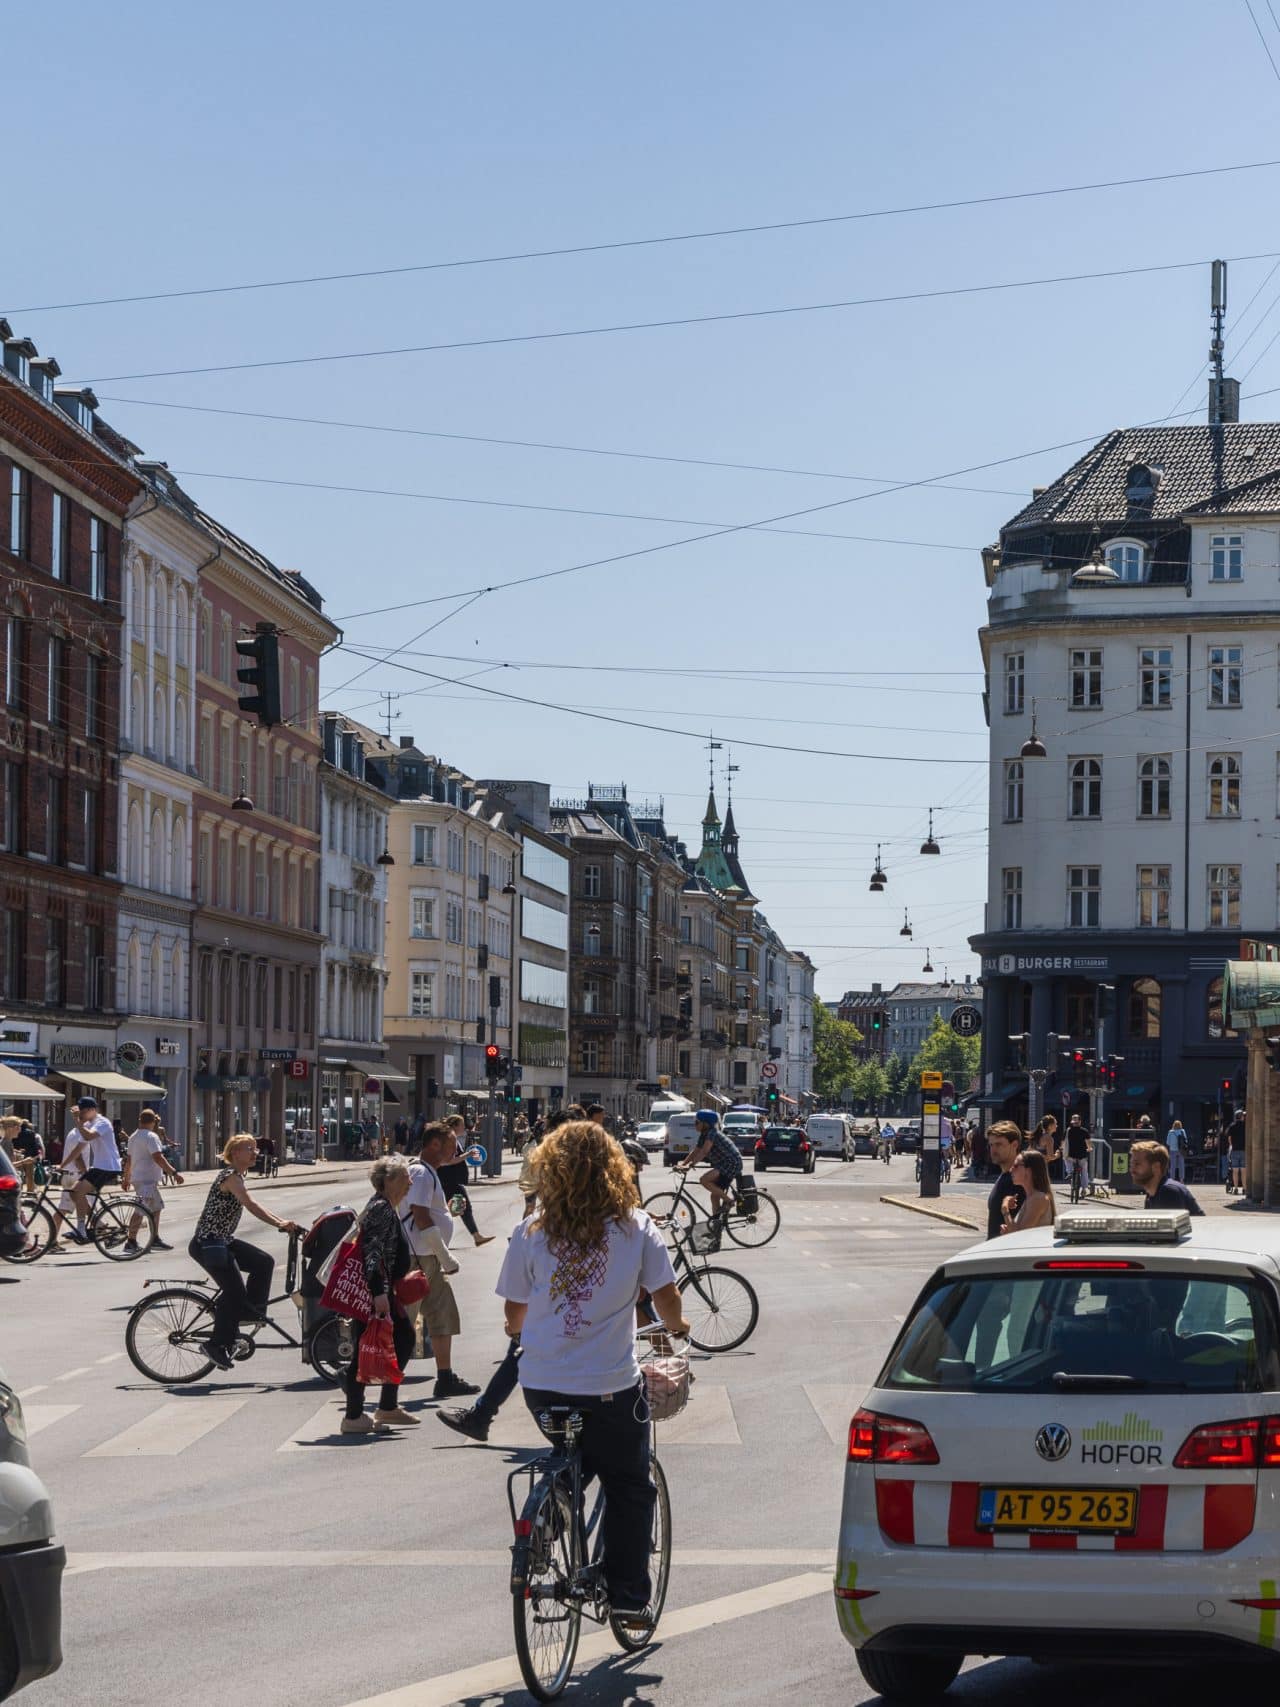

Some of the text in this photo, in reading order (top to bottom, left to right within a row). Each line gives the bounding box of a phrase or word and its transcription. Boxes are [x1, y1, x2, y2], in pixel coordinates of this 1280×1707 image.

[1018, 957, 1071, 969] BURGER
[1073, 959, 1108, 968] RESTAURANT
[961, 1014, 972, 1028] H
[262, 1051, 292, 1059] Bank
[293, 1061, 305, 1076] B
[1081, 1445, 1163, 1465] HOFOR
[982, 1510, 992, 1518] DK
[998, 1494, 1129, 1522] AT 95 263
